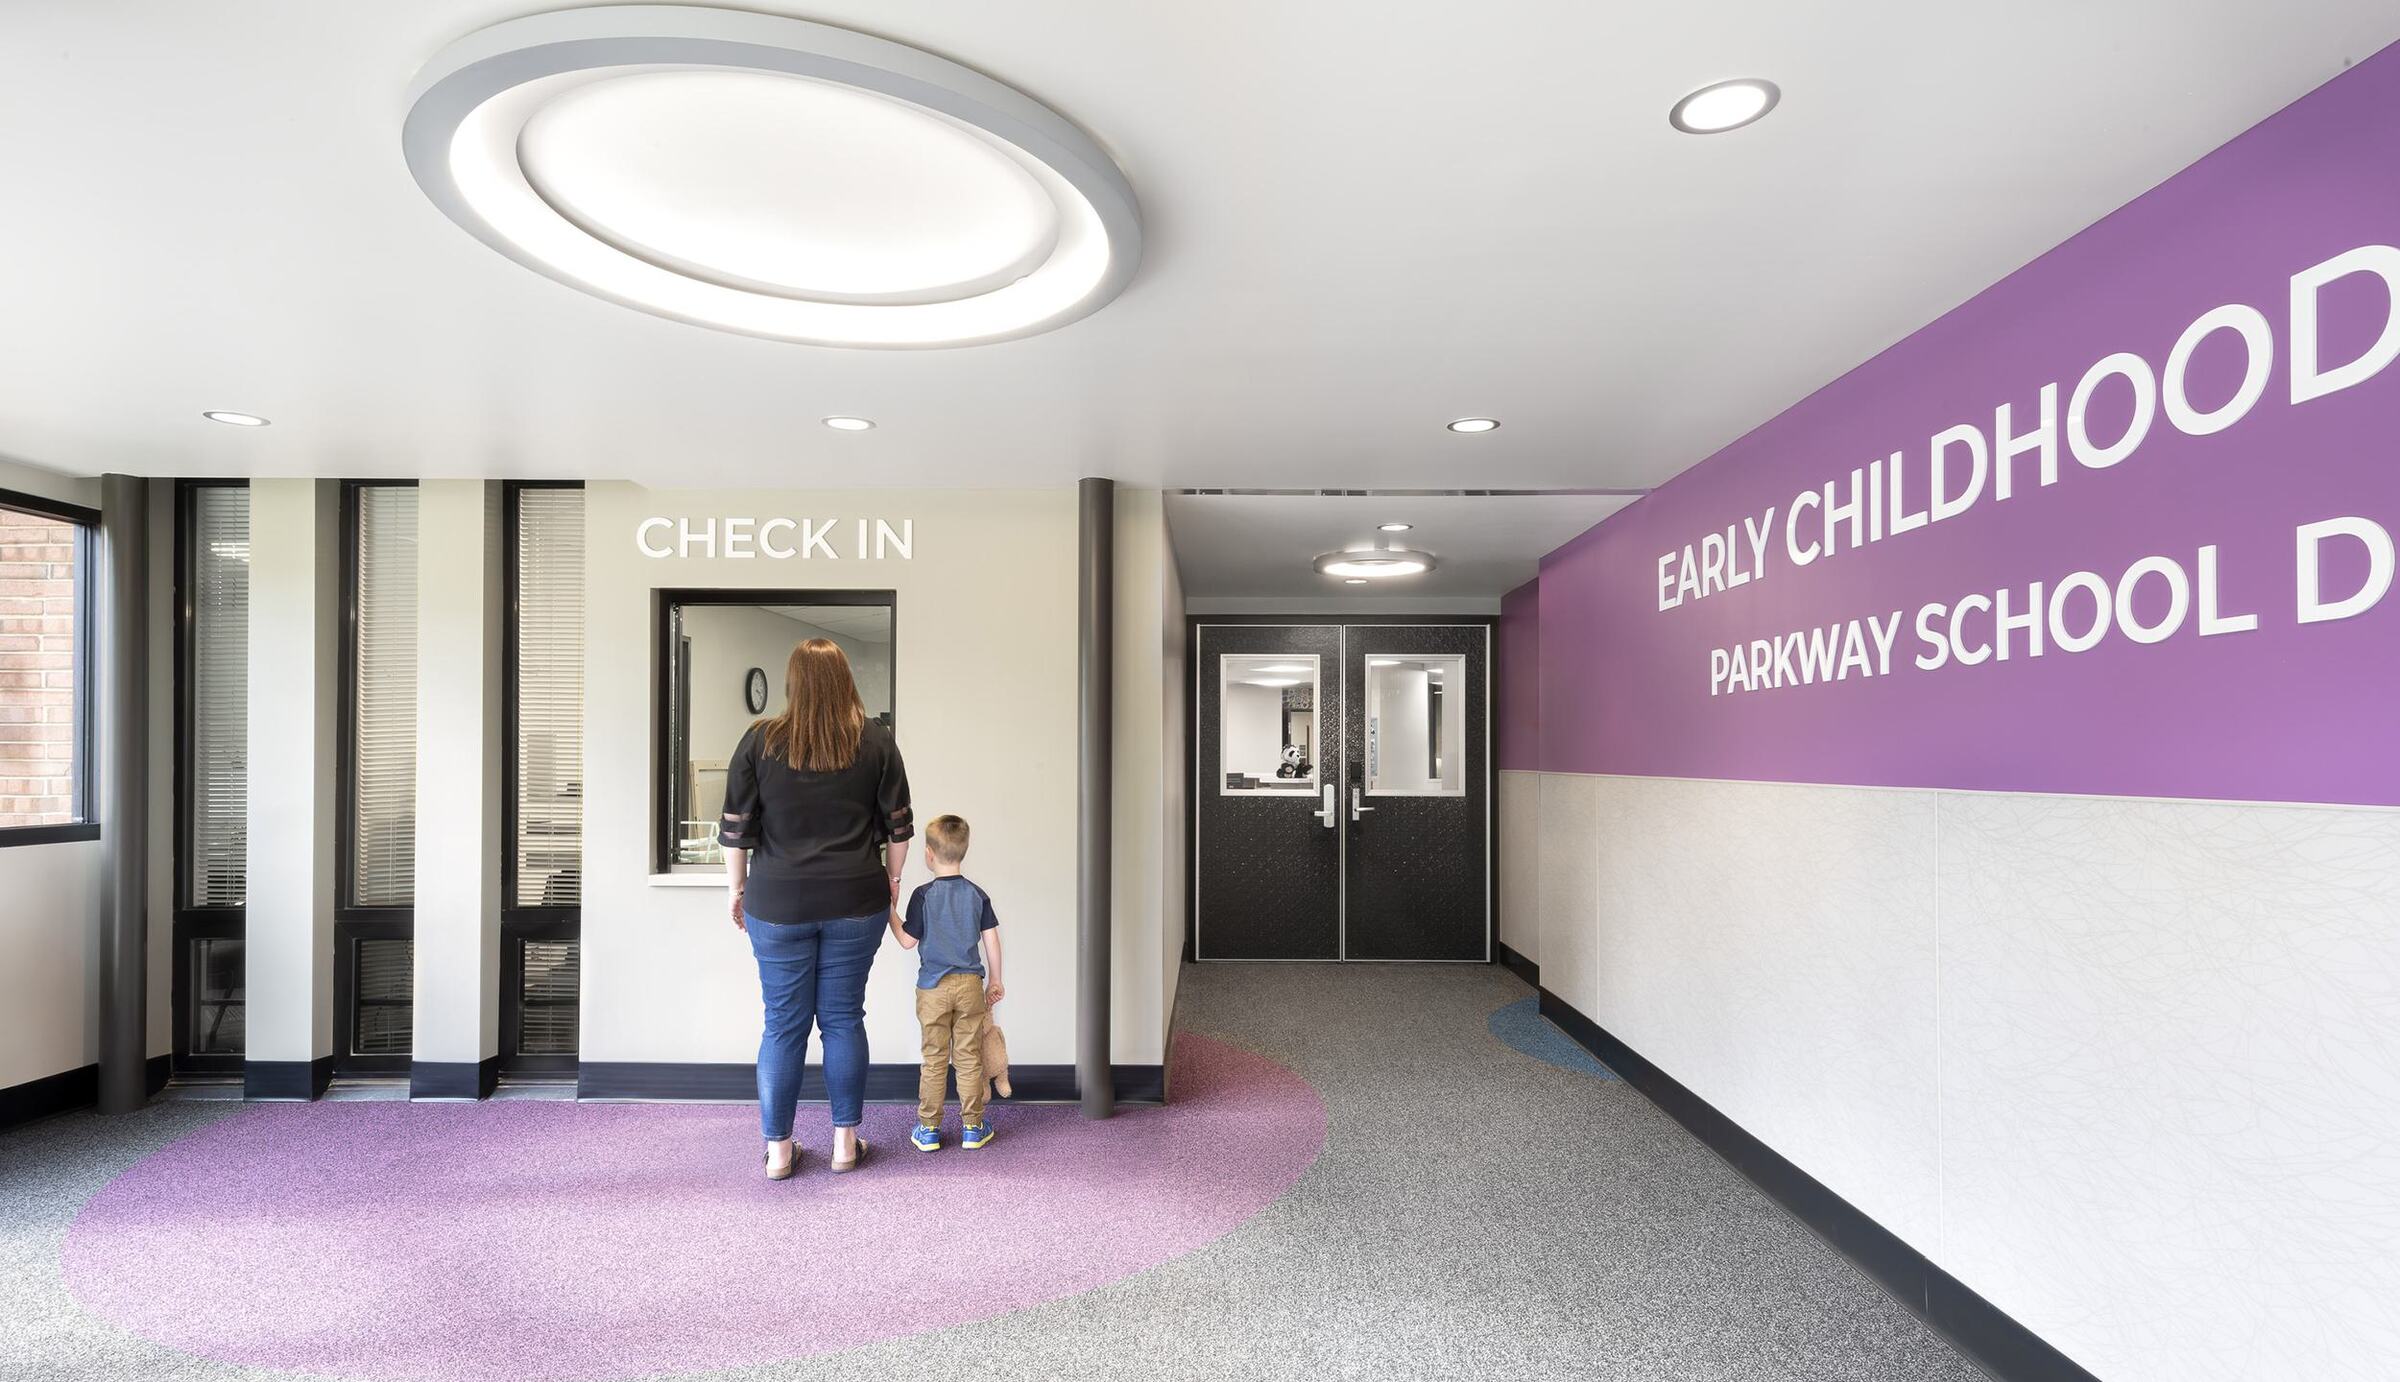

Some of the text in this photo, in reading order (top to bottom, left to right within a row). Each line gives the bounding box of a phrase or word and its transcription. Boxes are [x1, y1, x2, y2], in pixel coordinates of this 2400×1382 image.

[1658, 245, 2400, 612] EARLY CHILDHOOD
[635, 516, 914, 560] CHECK IN
[1711, 611, 1903, 696] PARKWAY
[1915, 544, 2258, 671] SCHOOL
